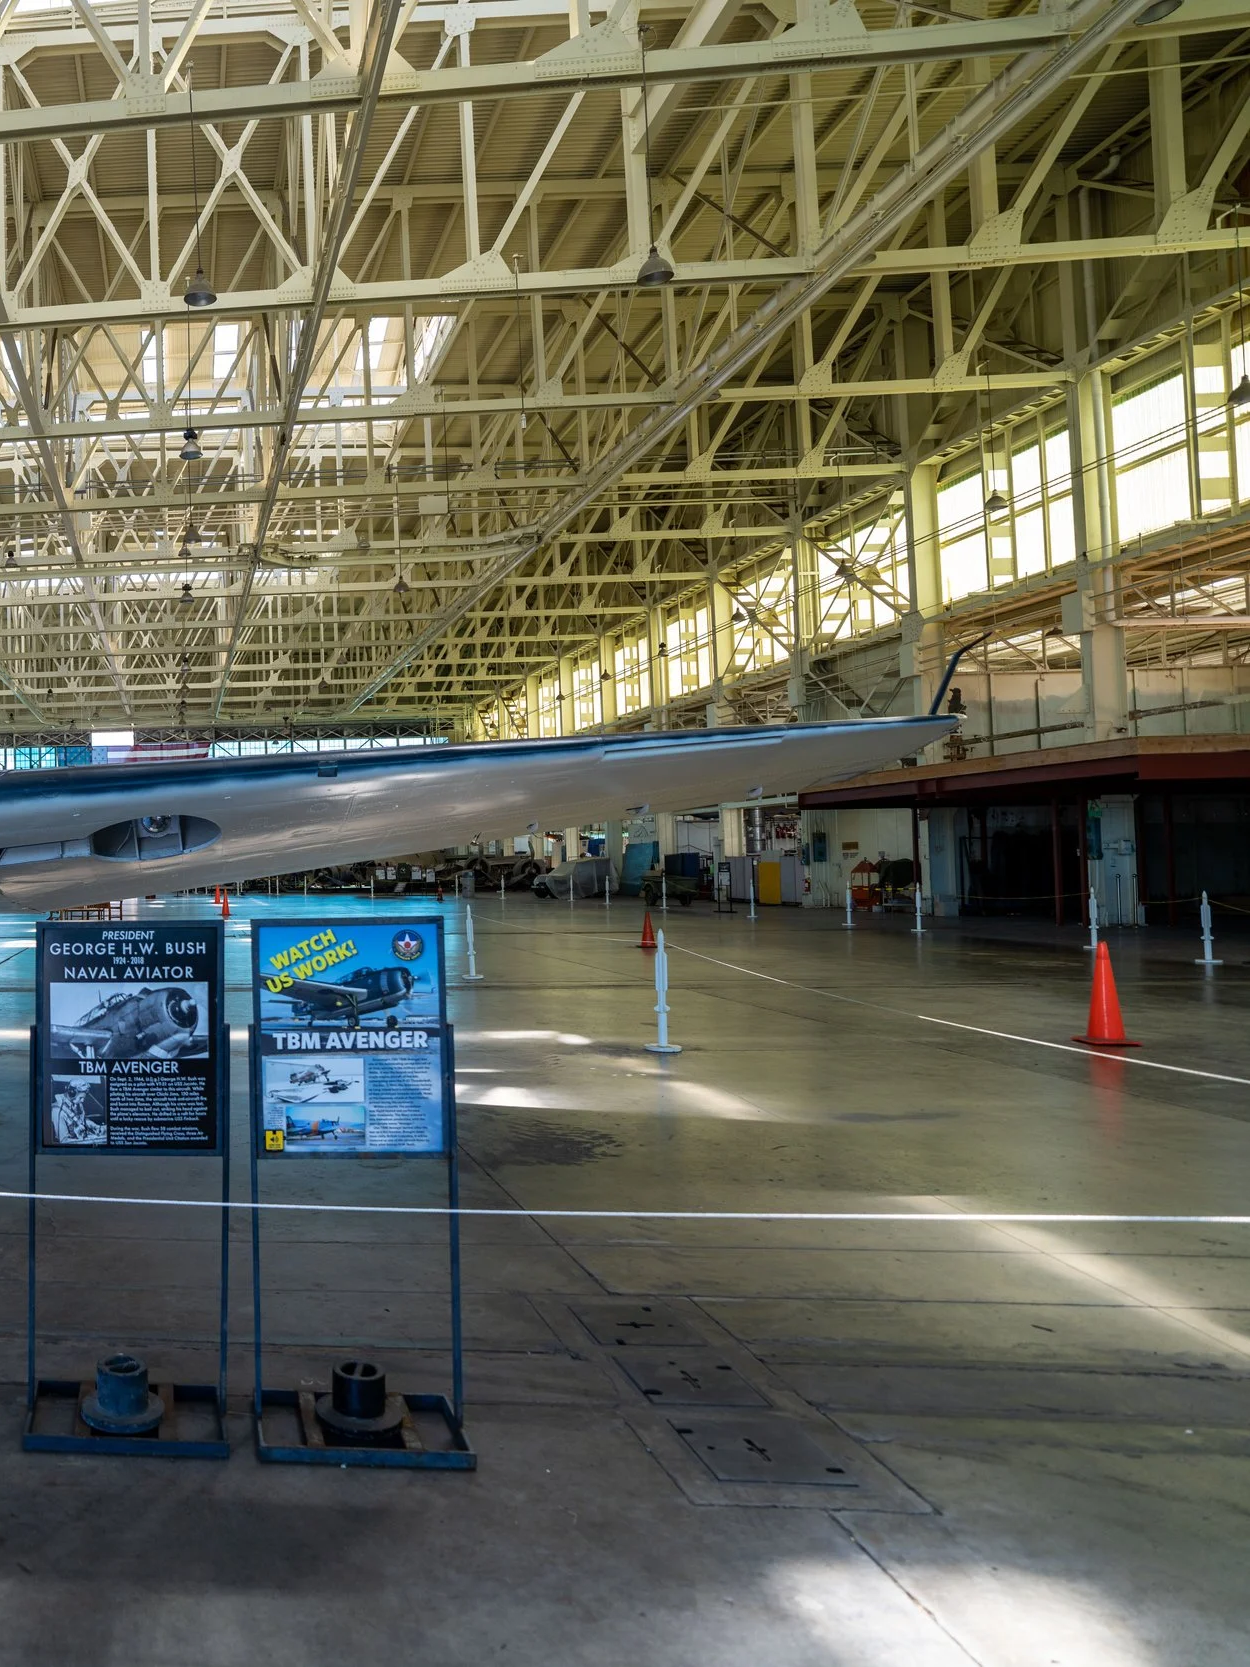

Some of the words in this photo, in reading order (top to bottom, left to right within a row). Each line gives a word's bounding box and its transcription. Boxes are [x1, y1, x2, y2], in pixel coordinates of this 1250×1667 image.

[102, 931, 155, 940] PRESIDENT
[50, 942, 115, 955] GEORGE
[122, 942, 158, 955] H.W.
[166, 942, 206, 954] BUSH
[269, 929, 337, 971] WATCH
[64, 967, 117, 979] NAVAL
[123, 966, 194, 979] AVIATOR
[266, 971, 294, 994] US
[293, 940, 358, 981] WORK!
[272, 1032, 321, 1050] TBM
[326, 1030, 428, 1050] AVENGER
[79, 1062, 106, 1074] TBM
[111, 1062, 179, 1074] AVENGER
